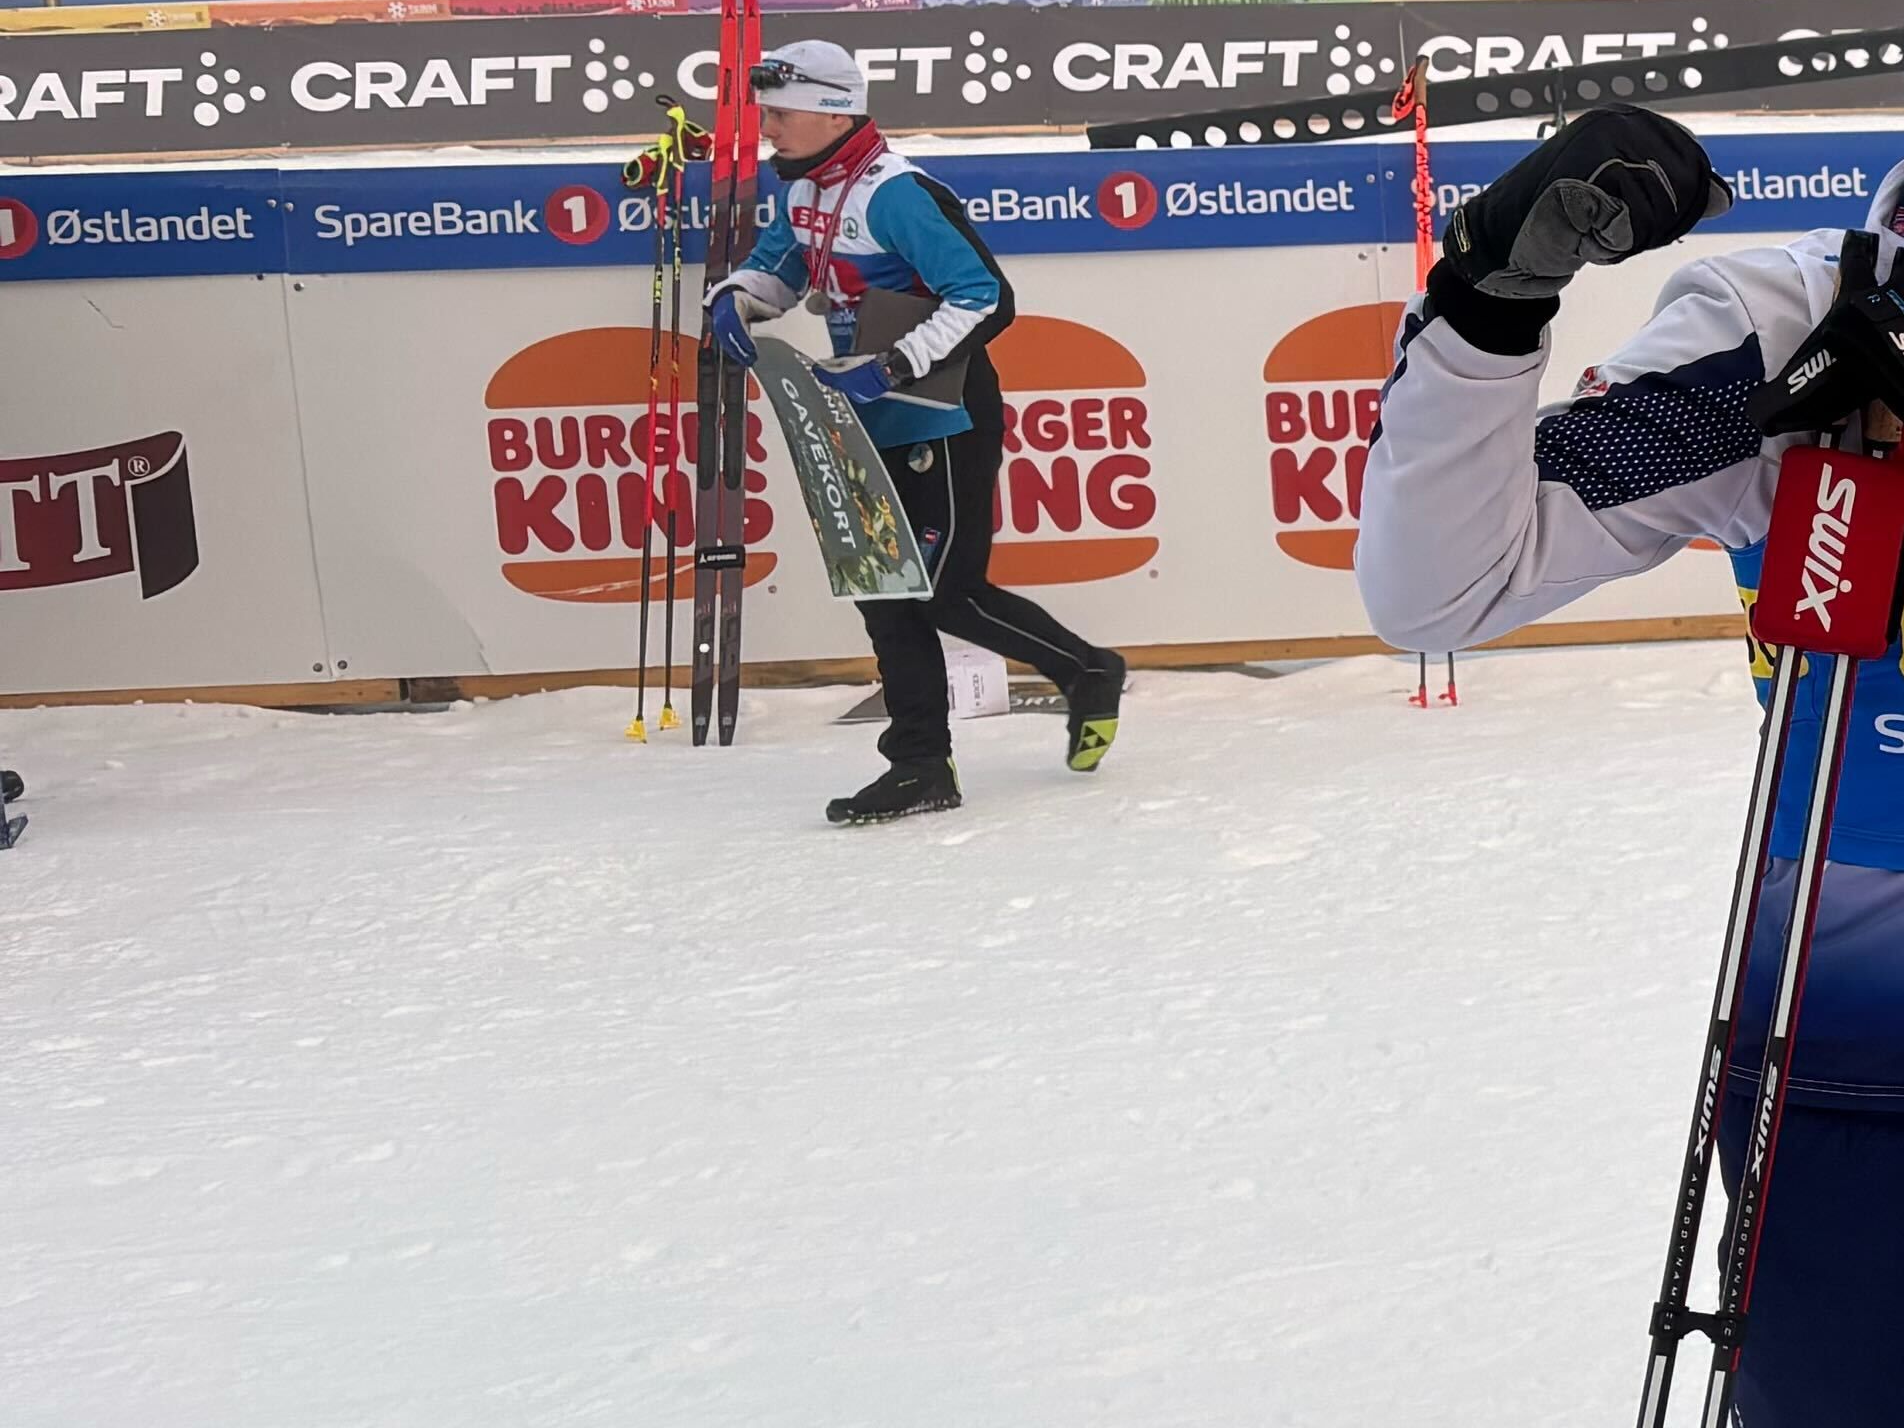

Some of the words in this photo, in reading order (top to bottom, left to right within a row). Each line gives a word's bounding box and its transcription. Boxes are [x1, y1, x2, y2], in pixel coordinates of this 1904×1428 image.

[290, 54, 572, 113] CRAFT
[676, 46, 952, 101] CFT
[1053, 40, 1318, 92] CRAFT
[0, 67, 183, 121] AFT
[961, 186, 1092, 223] reBank
[1112, 182, 1142, 220] 1
[1165, 177, 1355, 217] Østlandet
[1725, 166, 1868, 203] stlandet
[46, 206, 254, 245] Østlandet
[315, 200, 541, 246] SpareBank
[562, 195, 588, 234] 1
[1790, 349, 1837, 395] SWI
[781, 377, 857, 549] GAVEKORT
